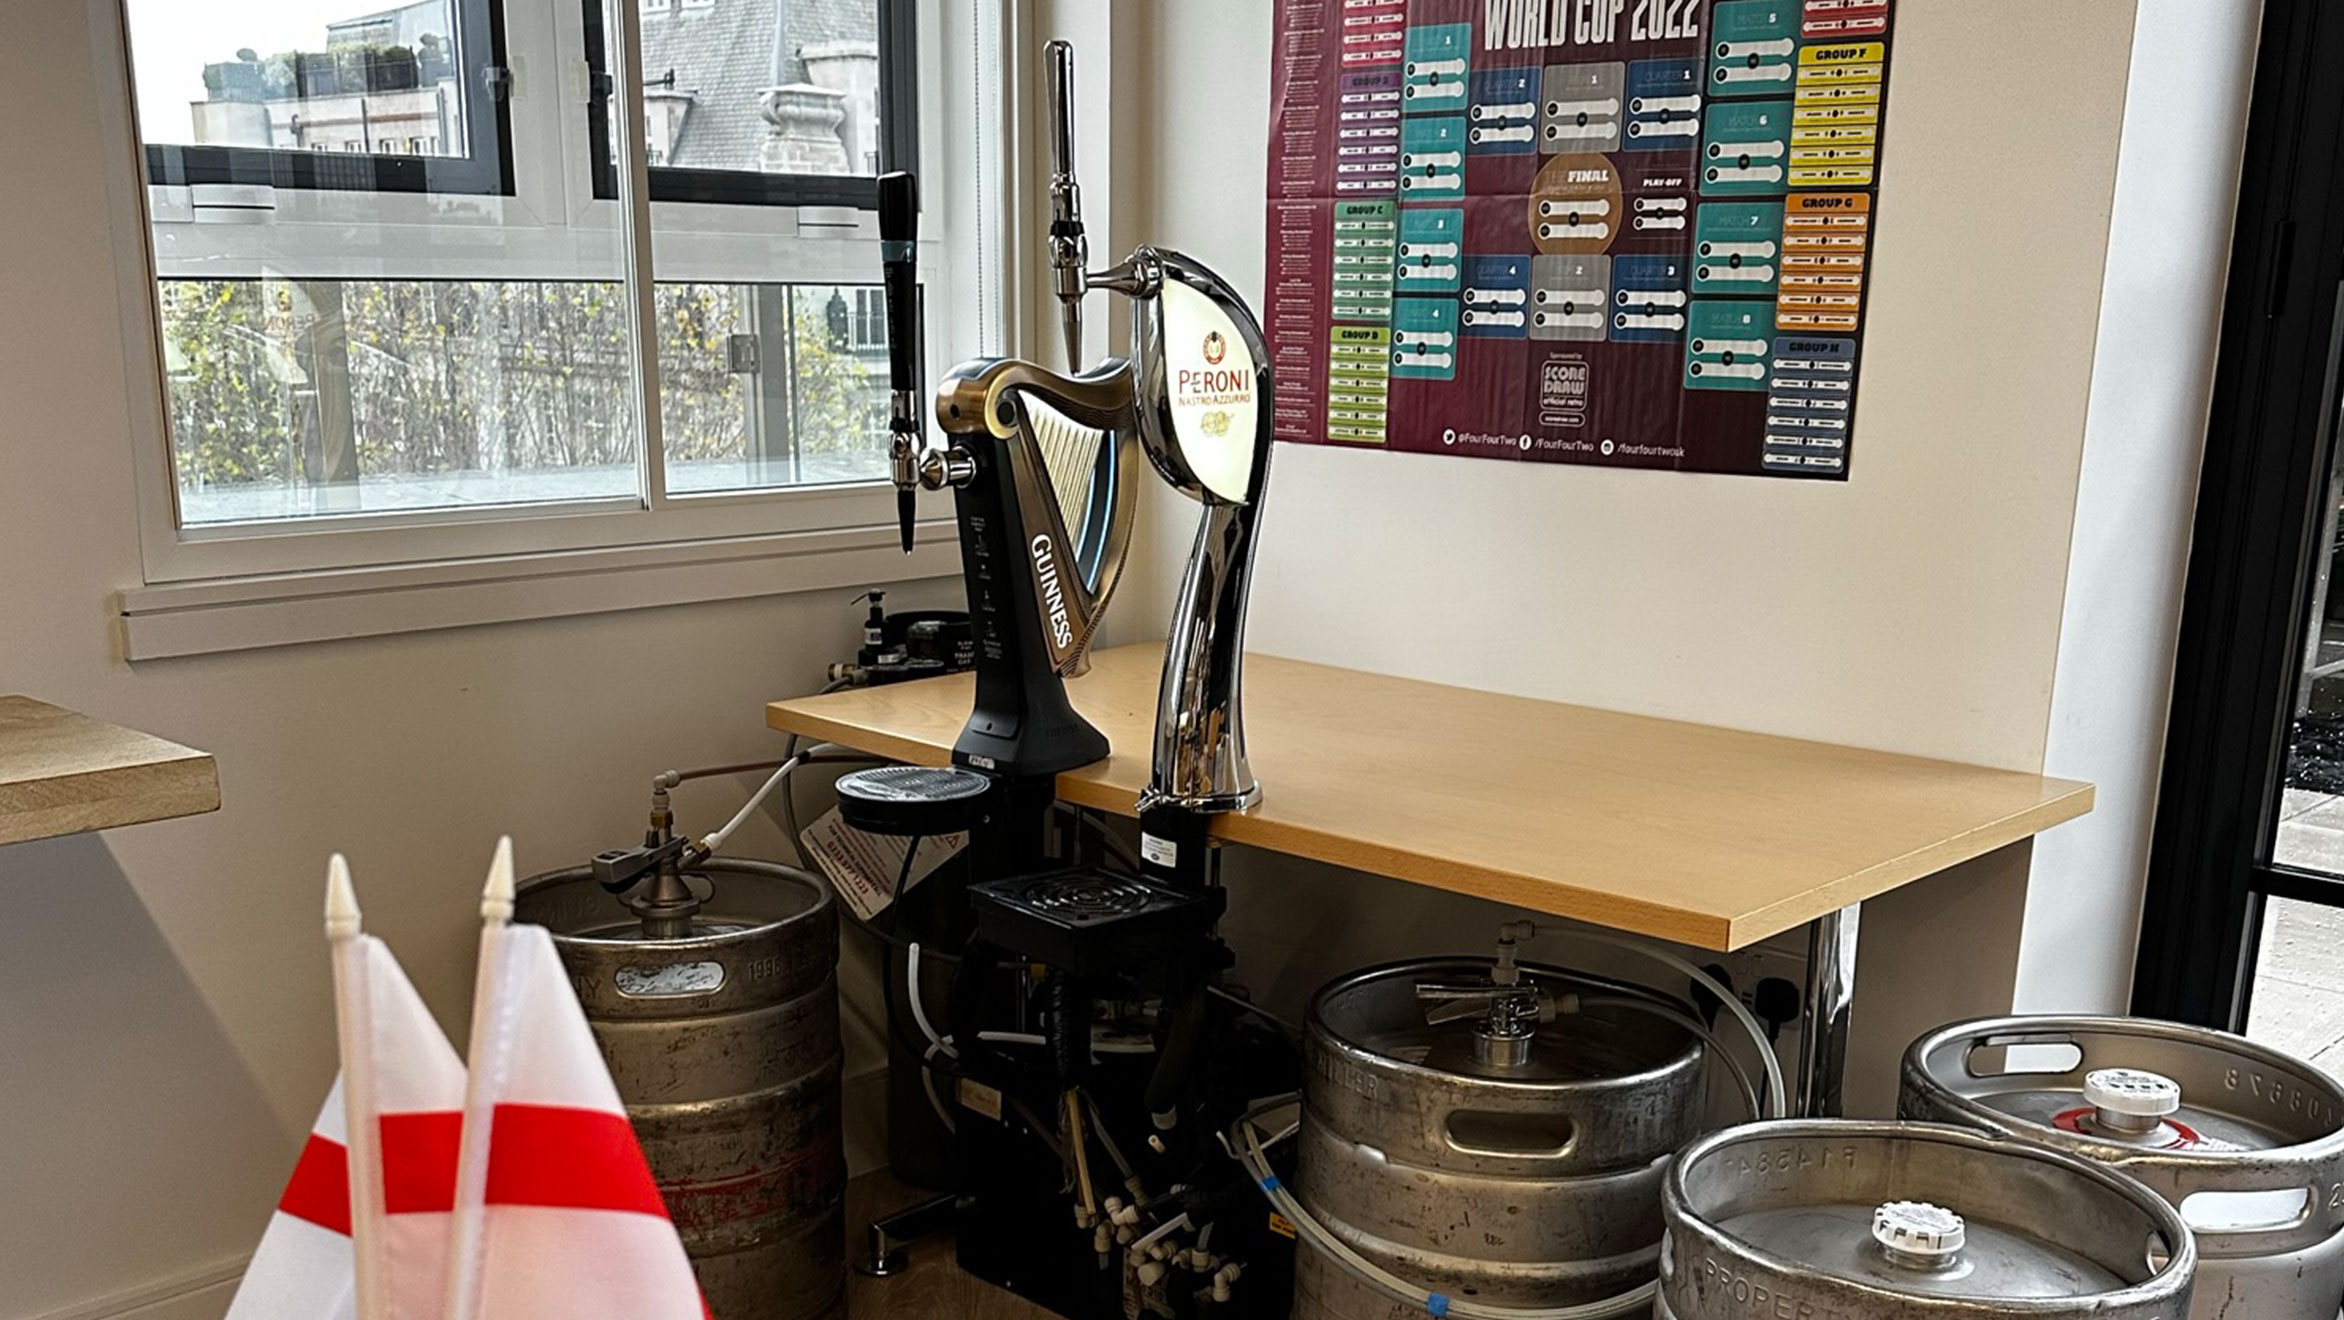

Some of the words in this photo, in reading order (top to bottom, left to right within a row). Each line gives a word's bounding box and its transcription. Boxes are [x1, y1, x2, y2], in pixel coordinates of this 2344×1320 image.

[1484, 0, 1567, 50] WORLD
[1574, 0, 1624, 44] CUP
[1631, 0, 1698, 41] 2022
[1816, 49, 1857, 60] GROUP
[1859, 48, 1867, 58] F
[1759, 114, 1768, 126] 6
[1568, 169, 1609, 183] FINAL
[1802, 198, 1843, 209] GROUP
[1347, 206, 1376, 215] GROUP
[1377, 206, 1384, 214] C
[1750, 216, 1759, 226] 7
[1575, 266, 1584, 275] 2
[1342, 330, 1370, 340] GROUP
[1788, 342, 1828, 353] GROUP
[1544, 366, 1586, 380] SCORE
[1178, 369, 1250, 394] PERONI
[1543, 380, 1585, 395] DRAW
[1458, 433, 1517, 446] @FourFourTwo
[1535, 439, 1595, 452] /FourFourTwo
[1031, 533, 1074, 650] GUINNESS
